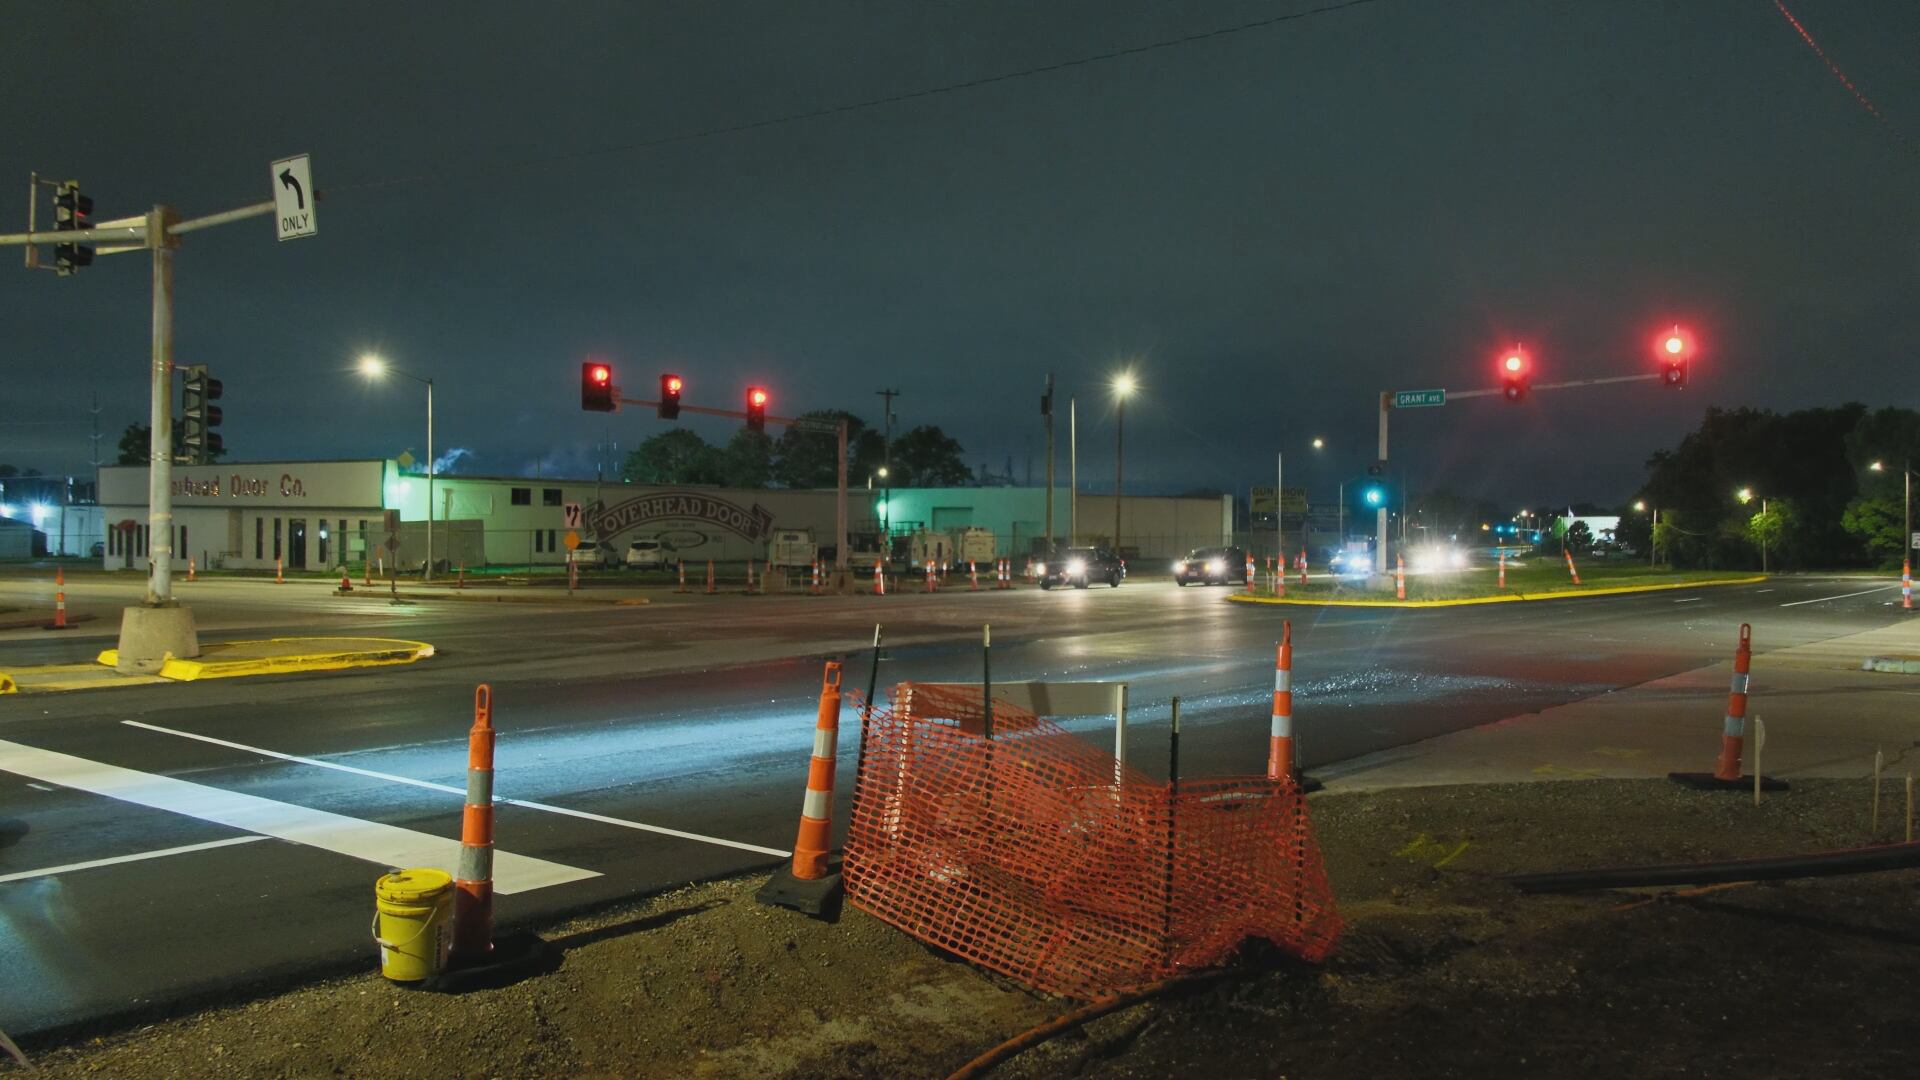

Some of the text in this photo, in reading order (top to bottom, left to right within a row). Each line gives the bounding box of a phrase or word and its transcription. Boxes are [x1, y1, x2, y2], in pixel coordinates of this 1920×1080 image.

[282, 213, 309, 232] ONLY
[1400, 394, 1425, 404] GRANT
[231, 474, 268, 497] Door
[281, 473, 306, 497] Co.
[604, 498, 752, 533] OVERHEAD DOOR
